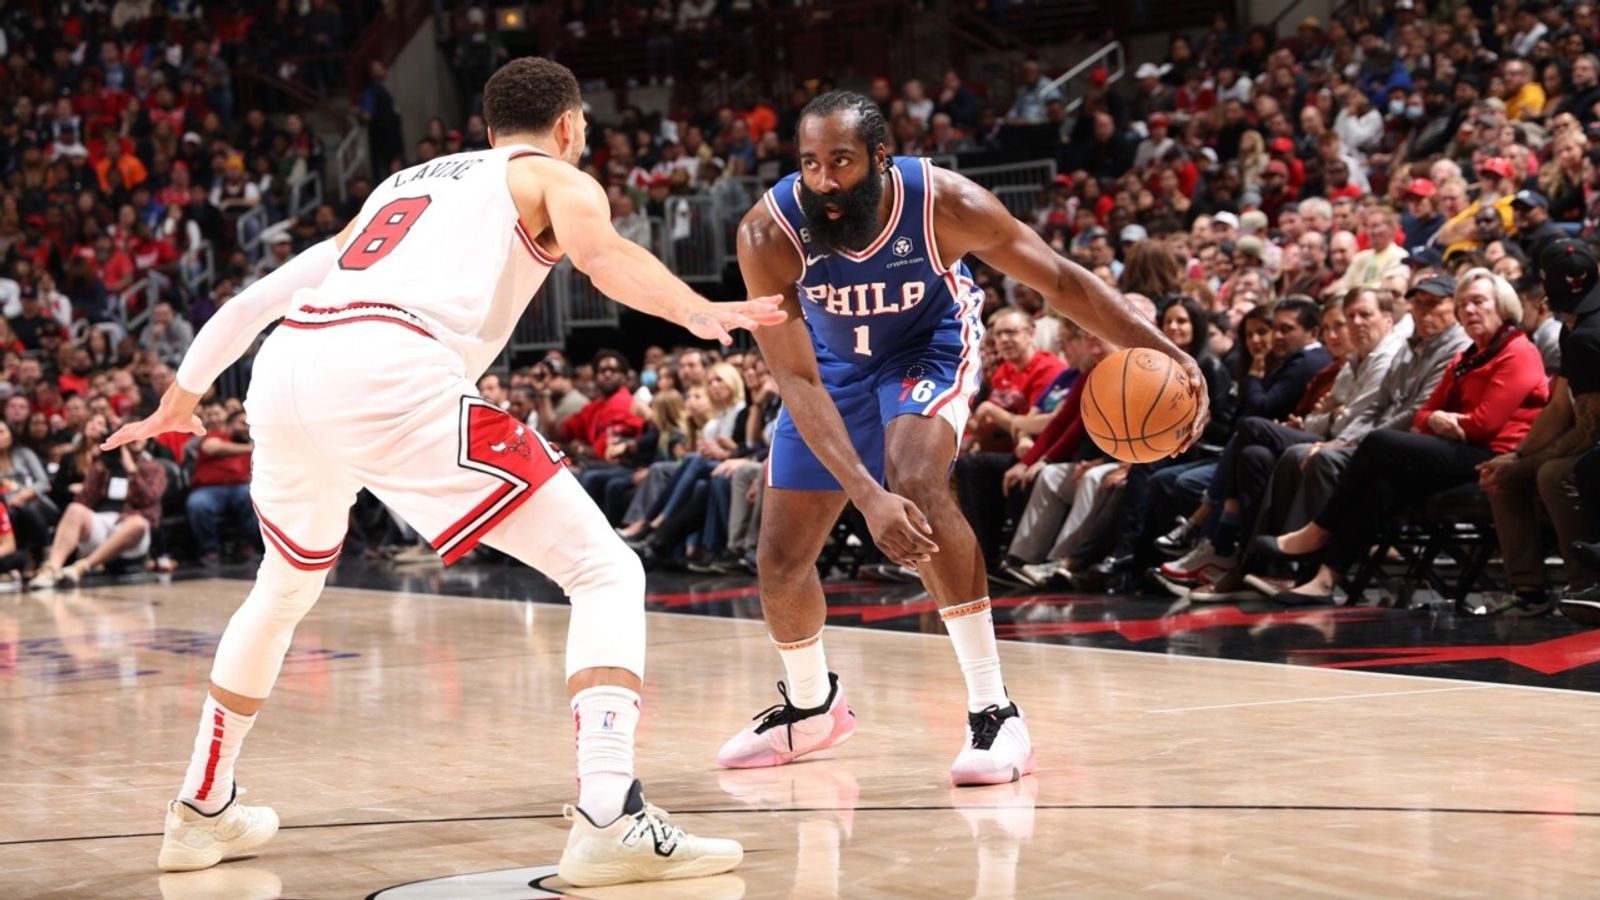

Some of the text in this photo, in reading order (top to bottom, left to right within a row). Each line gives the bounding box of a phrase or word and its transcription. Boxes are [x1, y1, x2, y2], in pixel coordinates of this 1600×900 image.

[337, 194, 432, 271] 8
[886, 257, 924, 269] crypto.com
[806, 281, 925, 317] PHILA
[854, 325, 872, 356] 1
[898, 379, 936, 403] 76
